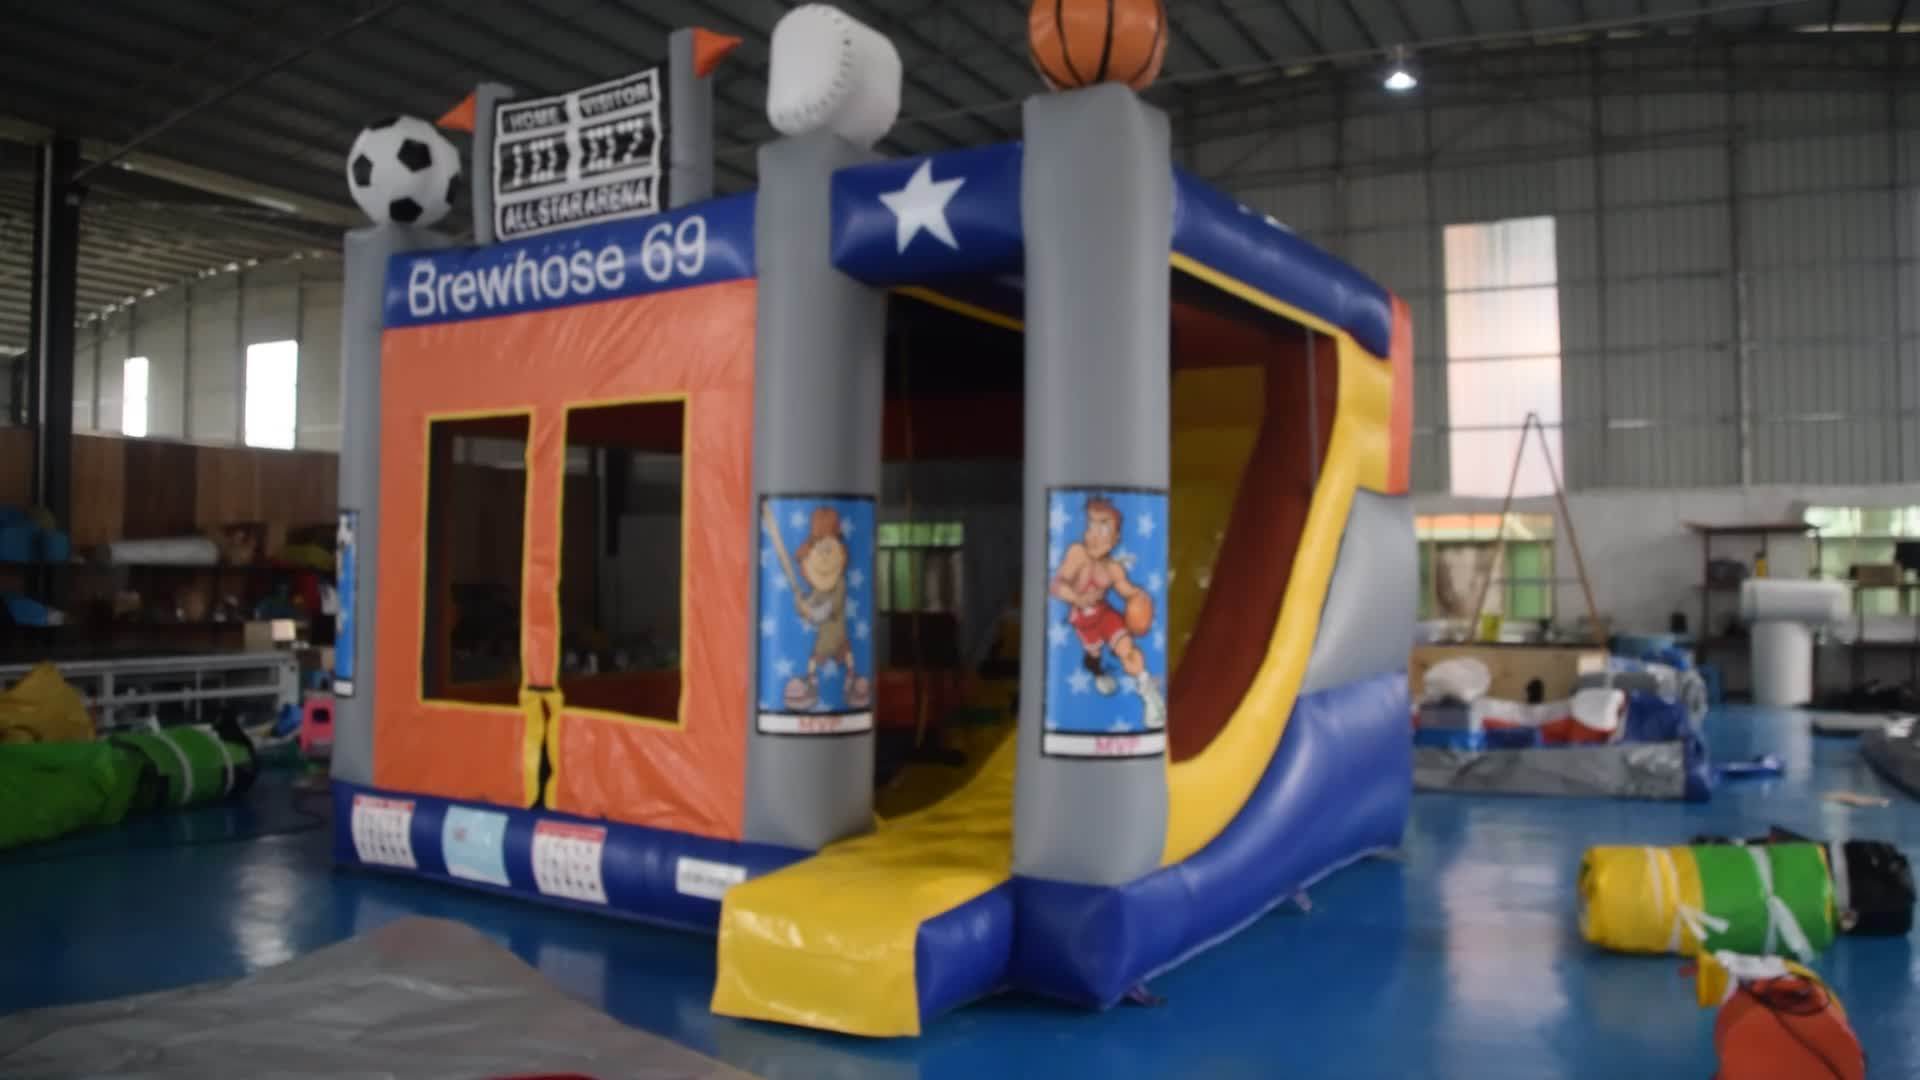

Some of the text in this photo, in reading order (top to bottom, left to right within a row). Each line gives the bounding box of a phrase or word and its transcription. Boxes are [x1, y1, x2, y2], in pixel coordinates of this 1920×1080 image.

[509, 82, 649, 131] HOME VISITOR
[584, 179, 649, 214] ARENA
[408, 215, 707, 317] Brewhose 69
